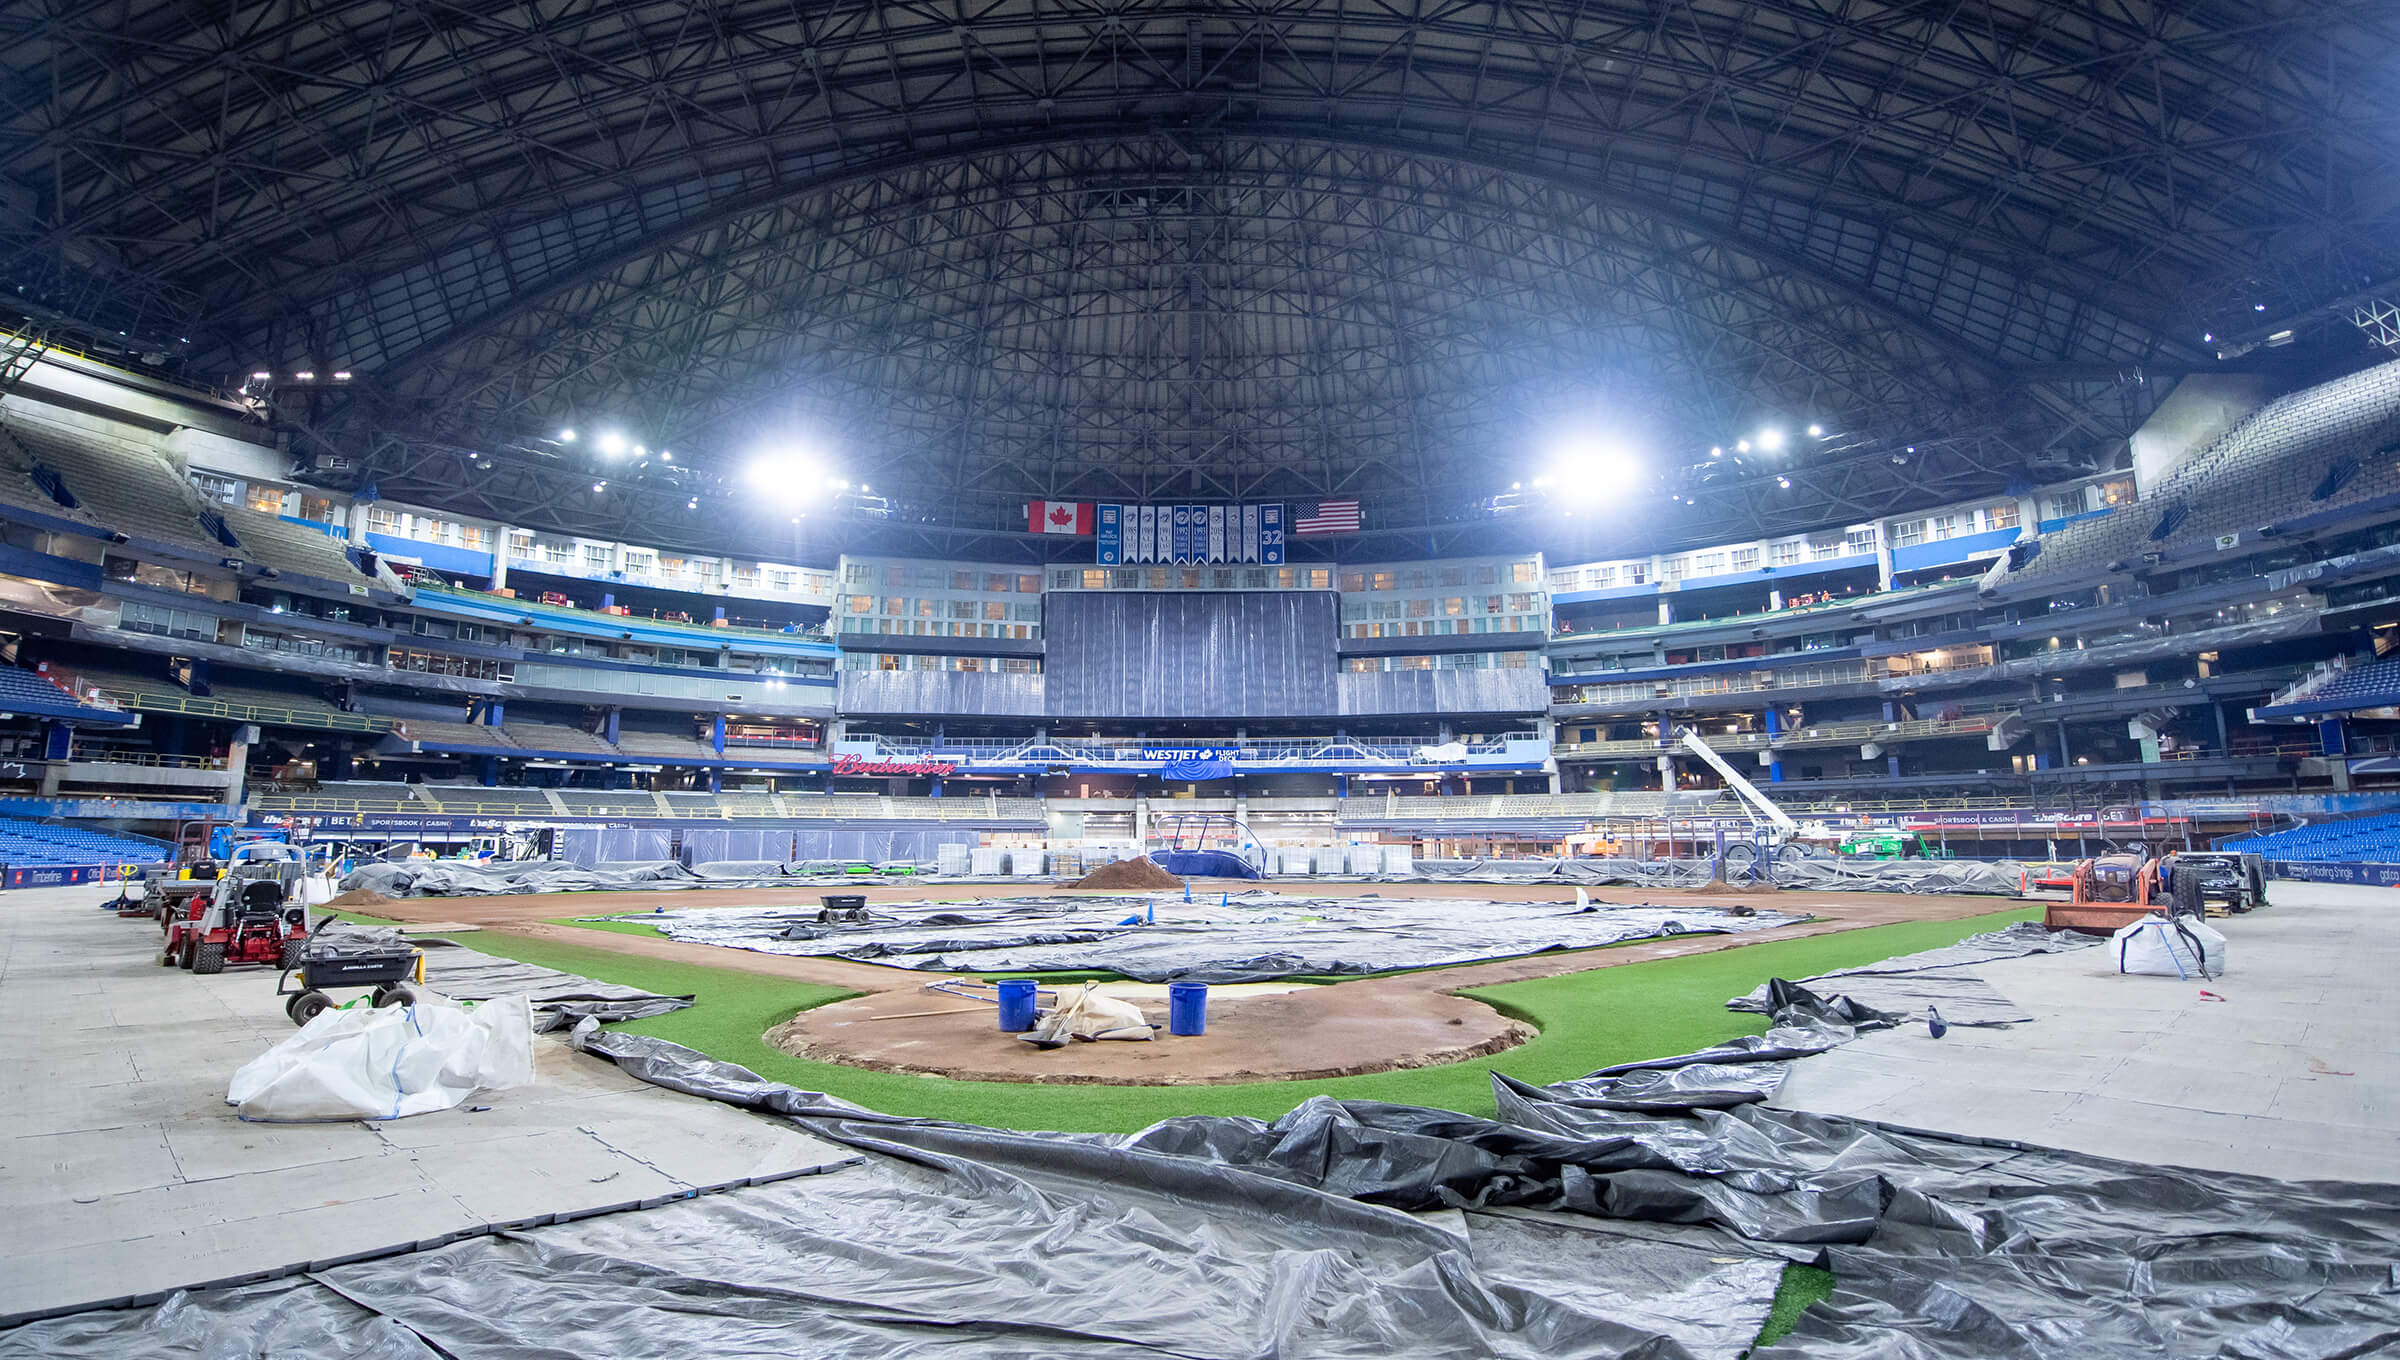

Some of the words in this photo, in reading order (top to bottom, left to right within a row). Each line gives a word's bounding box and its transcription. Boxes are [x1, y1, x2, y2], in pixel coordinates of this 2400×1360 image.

[1262, 530, 1282, 545] 32
[1143, 750, 1199, 761] WESTJET
[829, 753, 956, 775] Budweiser
[331, 816, 352, 825] BET
[2033, 812, 2093, 822] theScore
[32, 870, 62, 883] Timberline
[2312, 865, 2334, 880] Roofing
